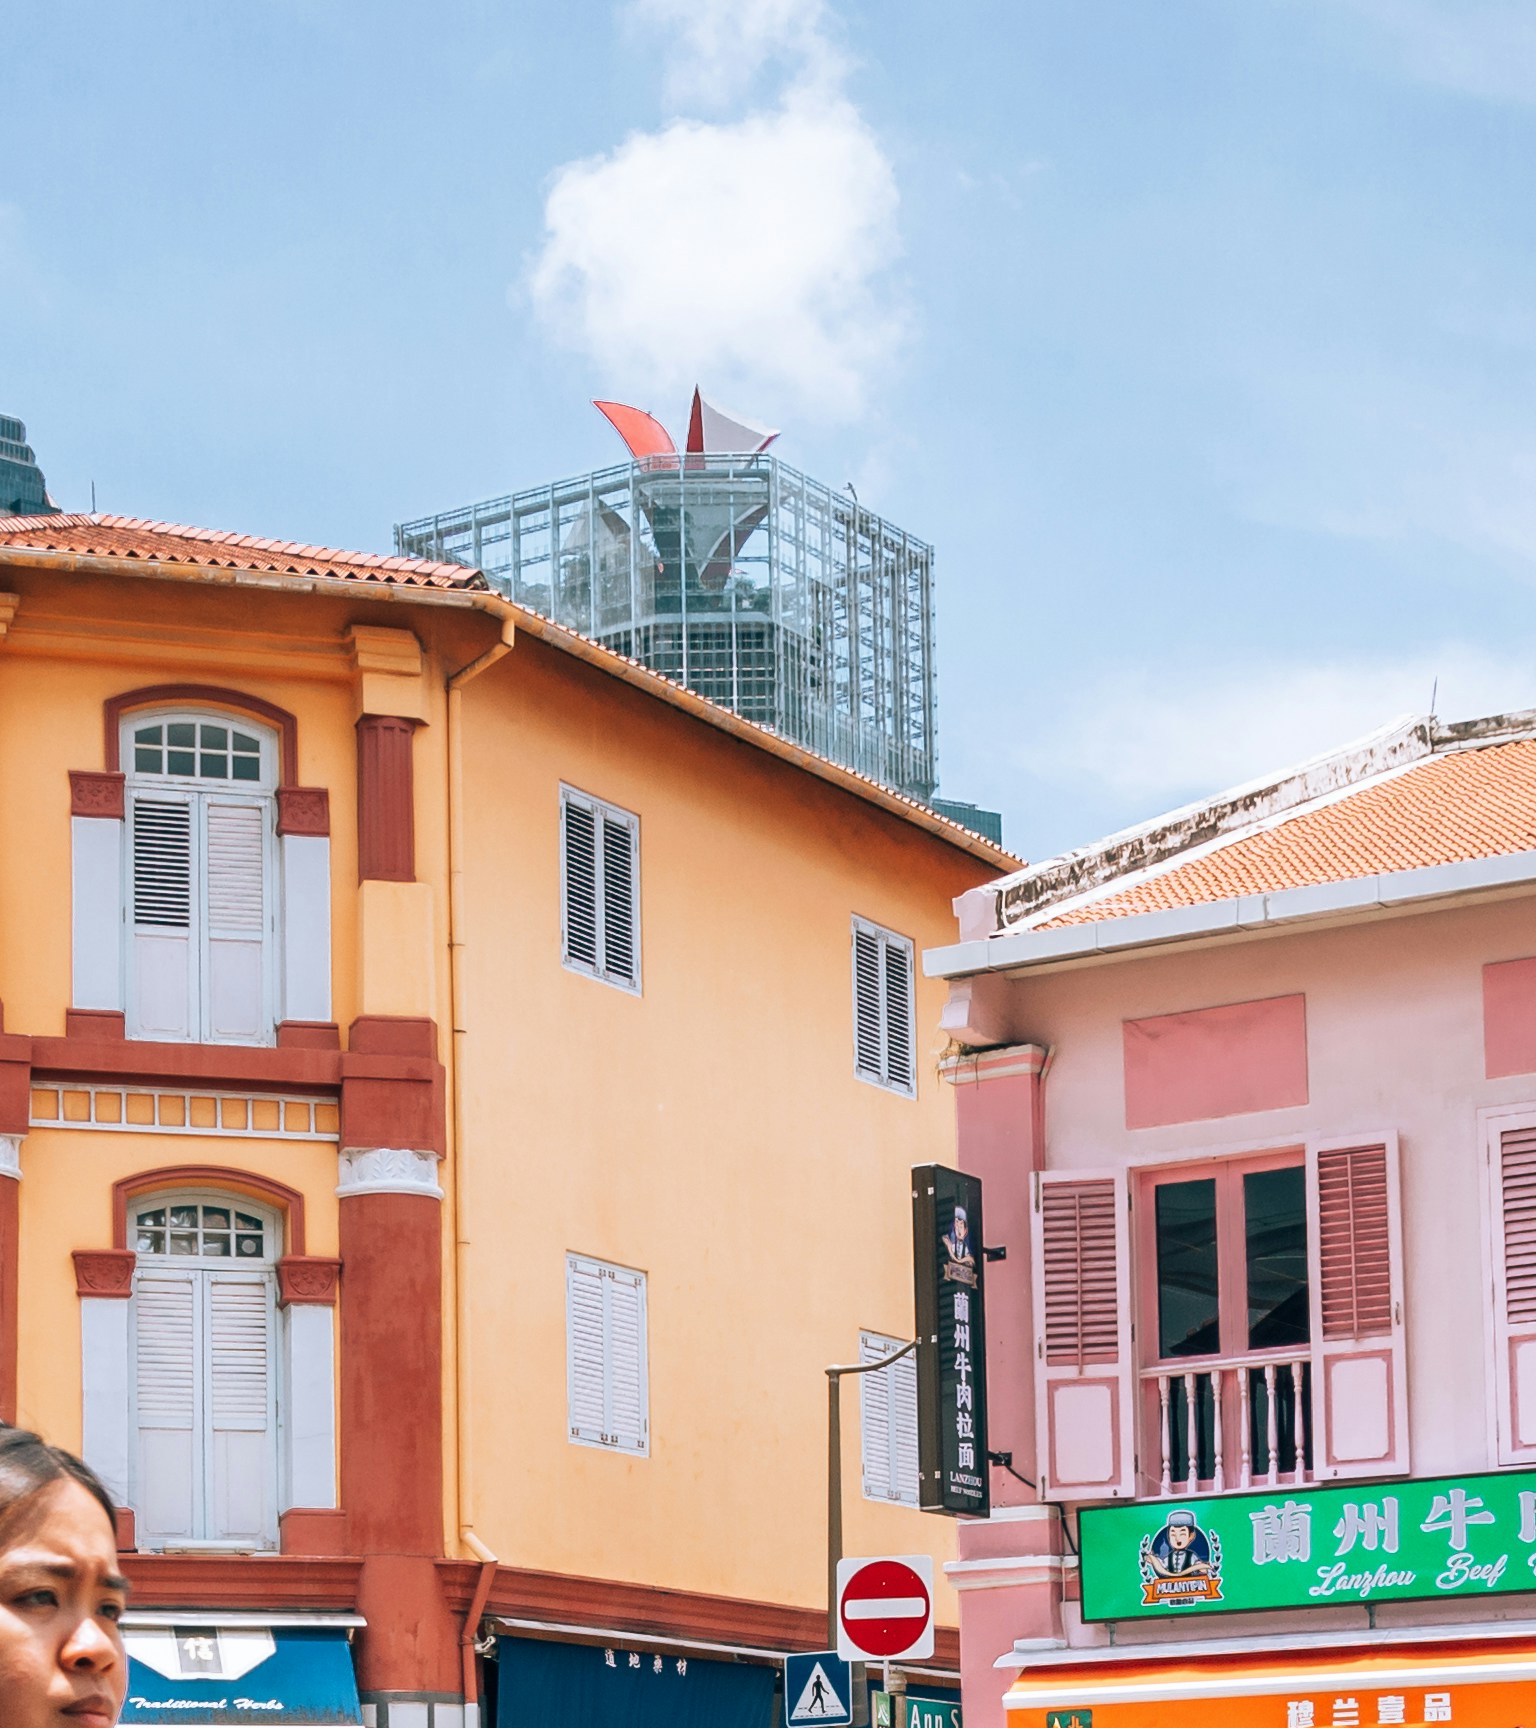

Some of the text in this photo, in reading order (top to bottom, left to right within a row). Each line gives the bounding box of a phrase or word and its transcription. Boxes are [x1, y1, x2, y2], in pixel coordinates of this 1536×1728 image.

[953, 1292, 975, 1470] 蘭州牛肉拉面
[949, 1471, 982, 1488] LANZHOU
[1308, 1563, 1416, 1598] Lanzhou
[1436, 1553, 1506, 1590] Beef
[128, 1697, 285, 1711] Traditional Herbs
